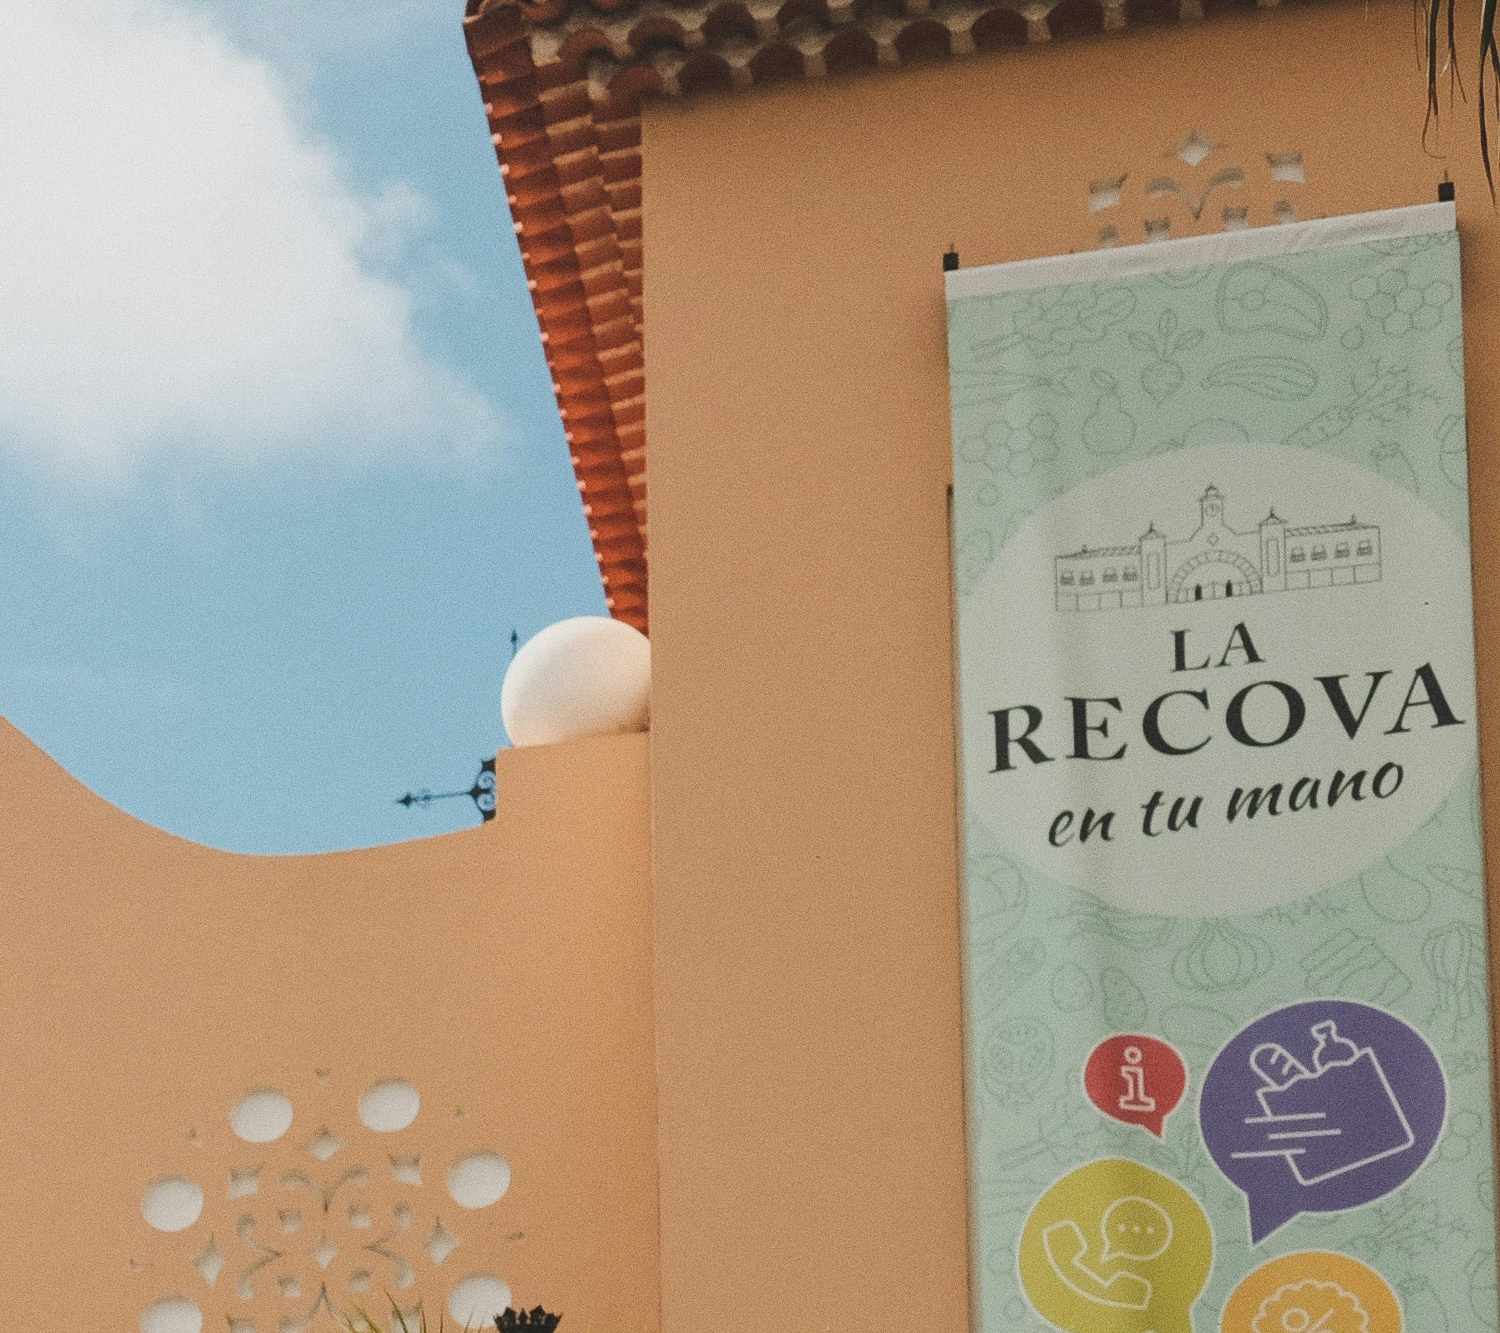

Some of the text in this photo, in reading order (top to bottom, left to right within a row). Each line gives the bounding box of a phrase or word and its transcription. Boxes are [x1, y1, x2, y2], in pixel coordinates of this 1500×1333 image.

[1169, 621, 1266, 674] LA
[987, 662, 1466, 775] RECOVA
[1047, 759, 1404, 848] en tu mano
